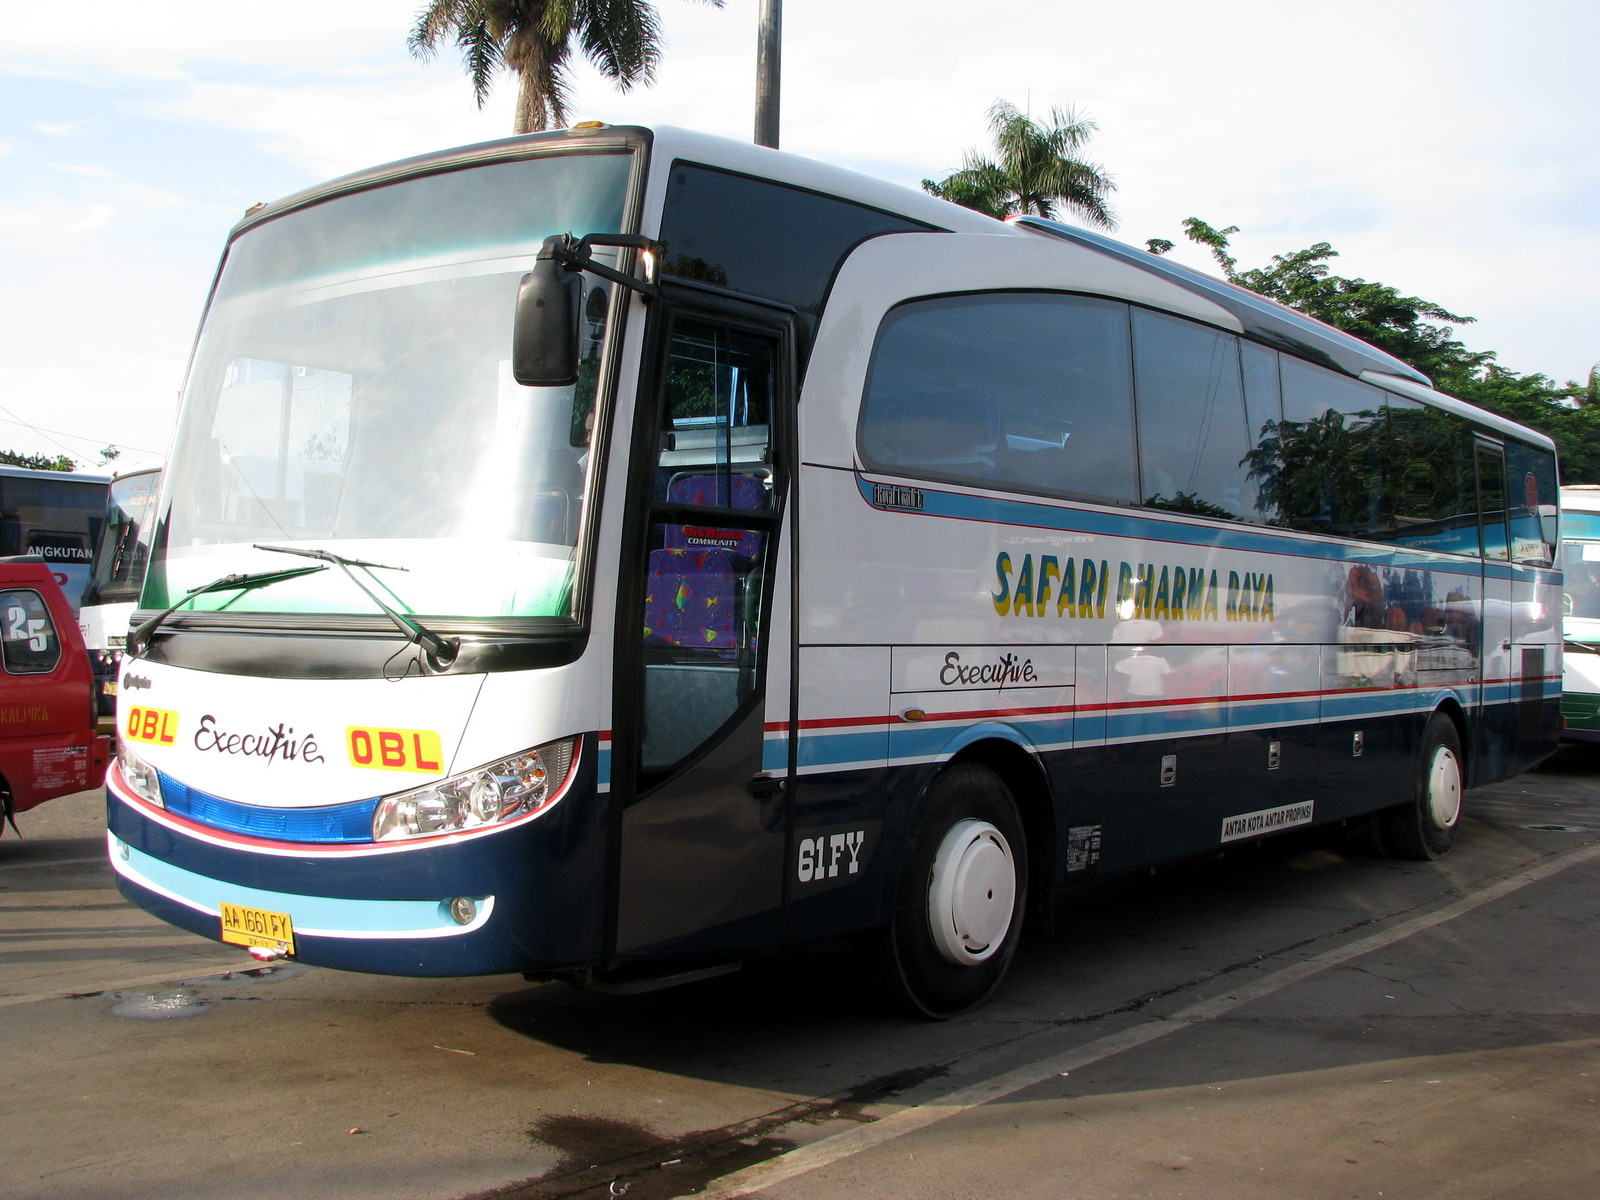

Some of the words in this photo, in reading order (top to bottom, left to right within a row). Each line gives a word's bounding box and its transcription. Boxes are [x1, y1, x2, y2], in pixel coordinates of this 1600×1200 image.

[27, 545, 93, 559] ANGKUTAN
[687, 537, 739, 547] COMMUNITY
[991, 551, 1109, 620] SAFARI
[1115, 561, 1219, 622] DHARMA
[1226, 570, 1274, 622] RAYA
[8, 607, 48, 651] 25
[939, 651, 1038, 695] Executive
[128, 708, 175, 743] OBL
[194, 714, 325, 767] Executive
[351, 730, 439, 770] OBL
[1224, 819, 1247, 837] ANTAR
[1247, 816, 1264, 832] KOTA
[1264, 810, 1285, 828] ANTAR
[1285, 804, 1312, 823] PROPINSI
[224, 906, 241, 928] AA
[242, 909, 268, 935] 1661
[270, 914, 286, 938] FY
